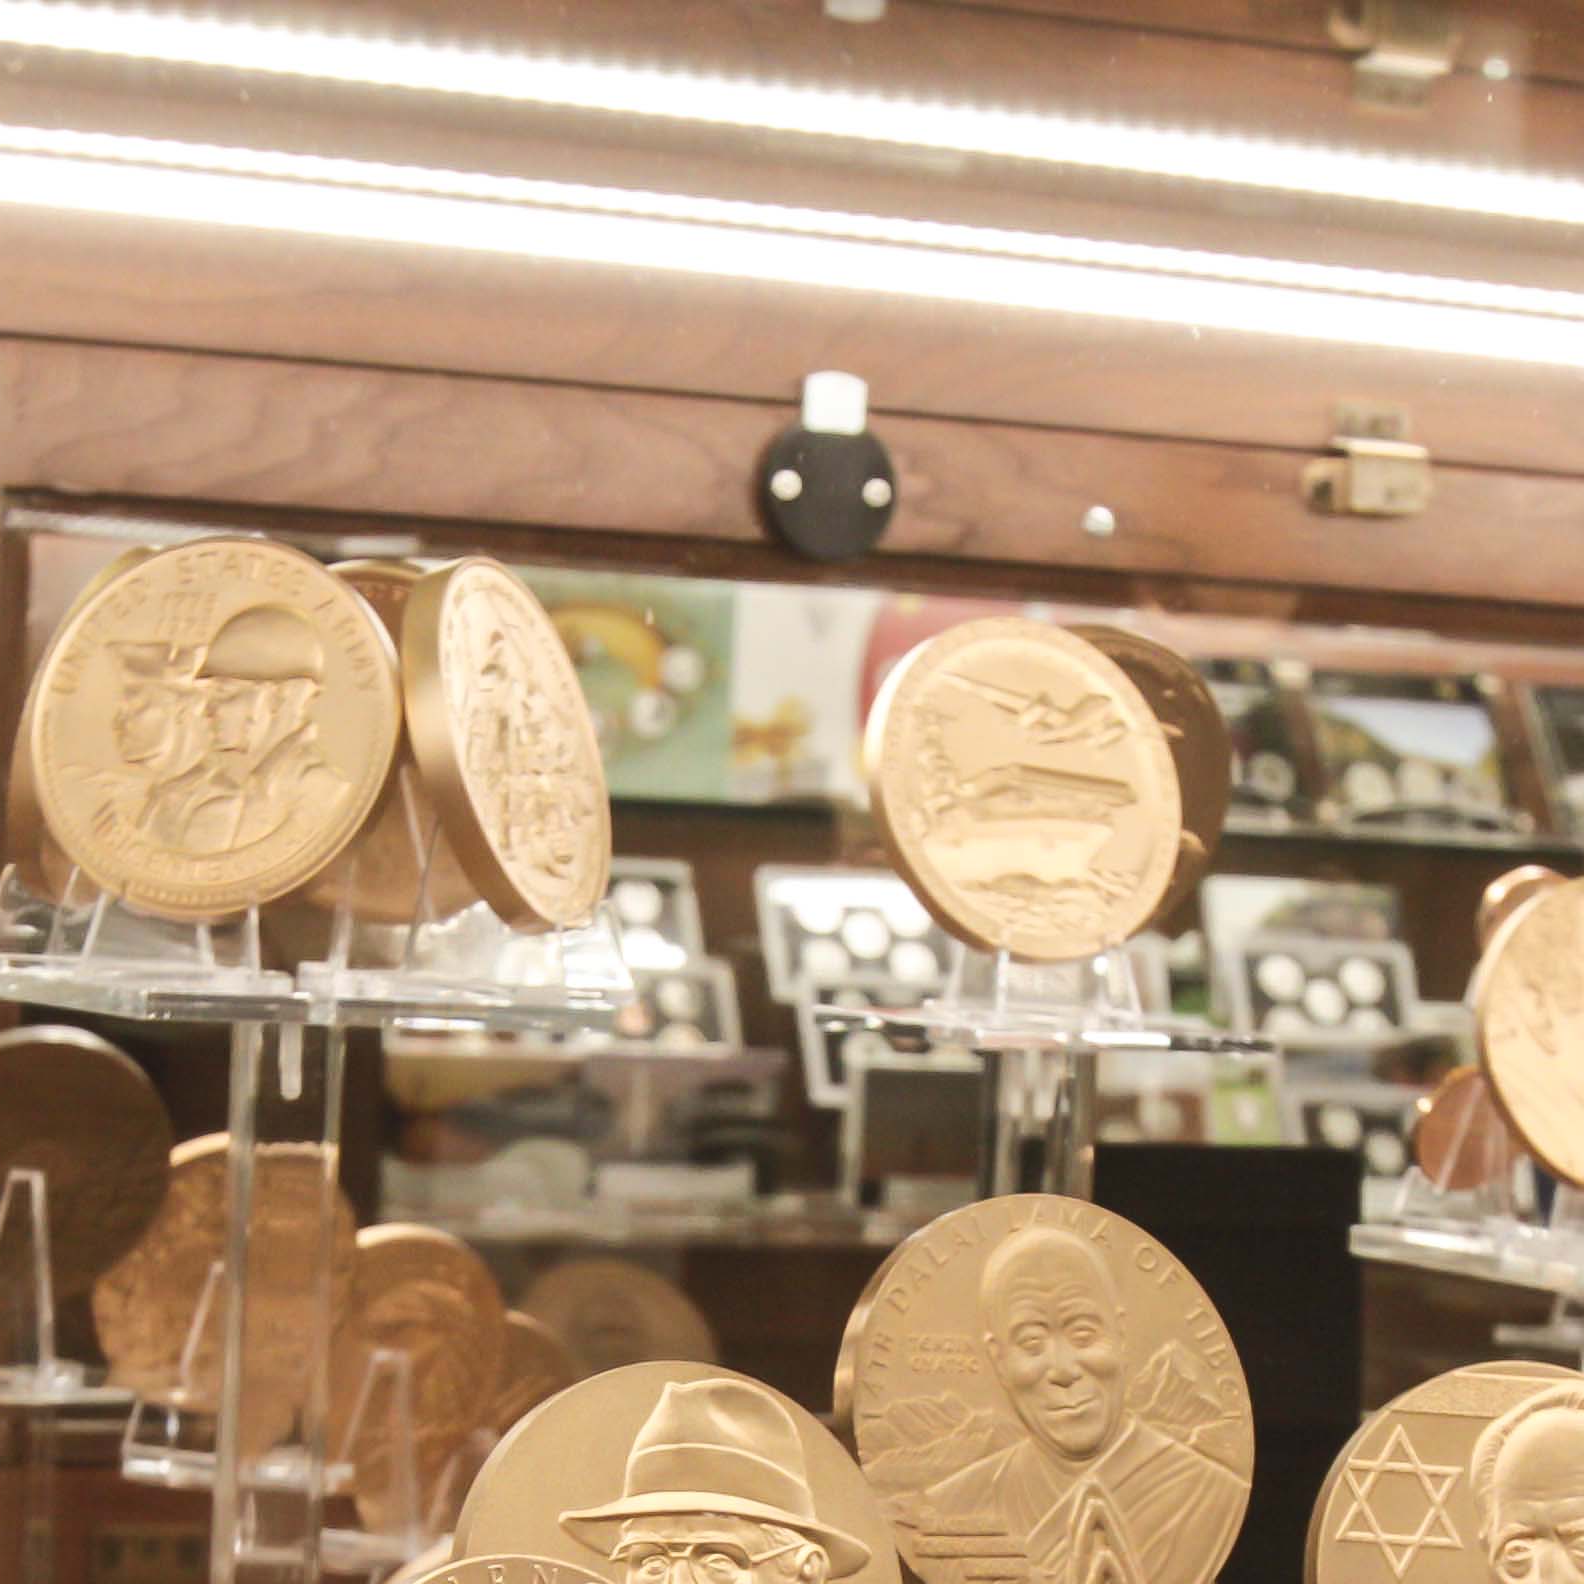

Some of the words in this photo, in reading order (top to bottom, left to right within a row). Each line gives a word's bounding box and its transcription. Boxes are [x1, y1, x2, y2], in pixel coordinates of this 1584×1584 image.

[176, 550, 308, 597] STATES
[312, 594, 380, 693] ARMY
[893, 1222, 990, 1314] DALAI
[1009, 1202, 1112, 1250] LAMA
[1135, 1245, 1184, 1291] OF
[1184, 1297, 1244, 1422] TIBET
